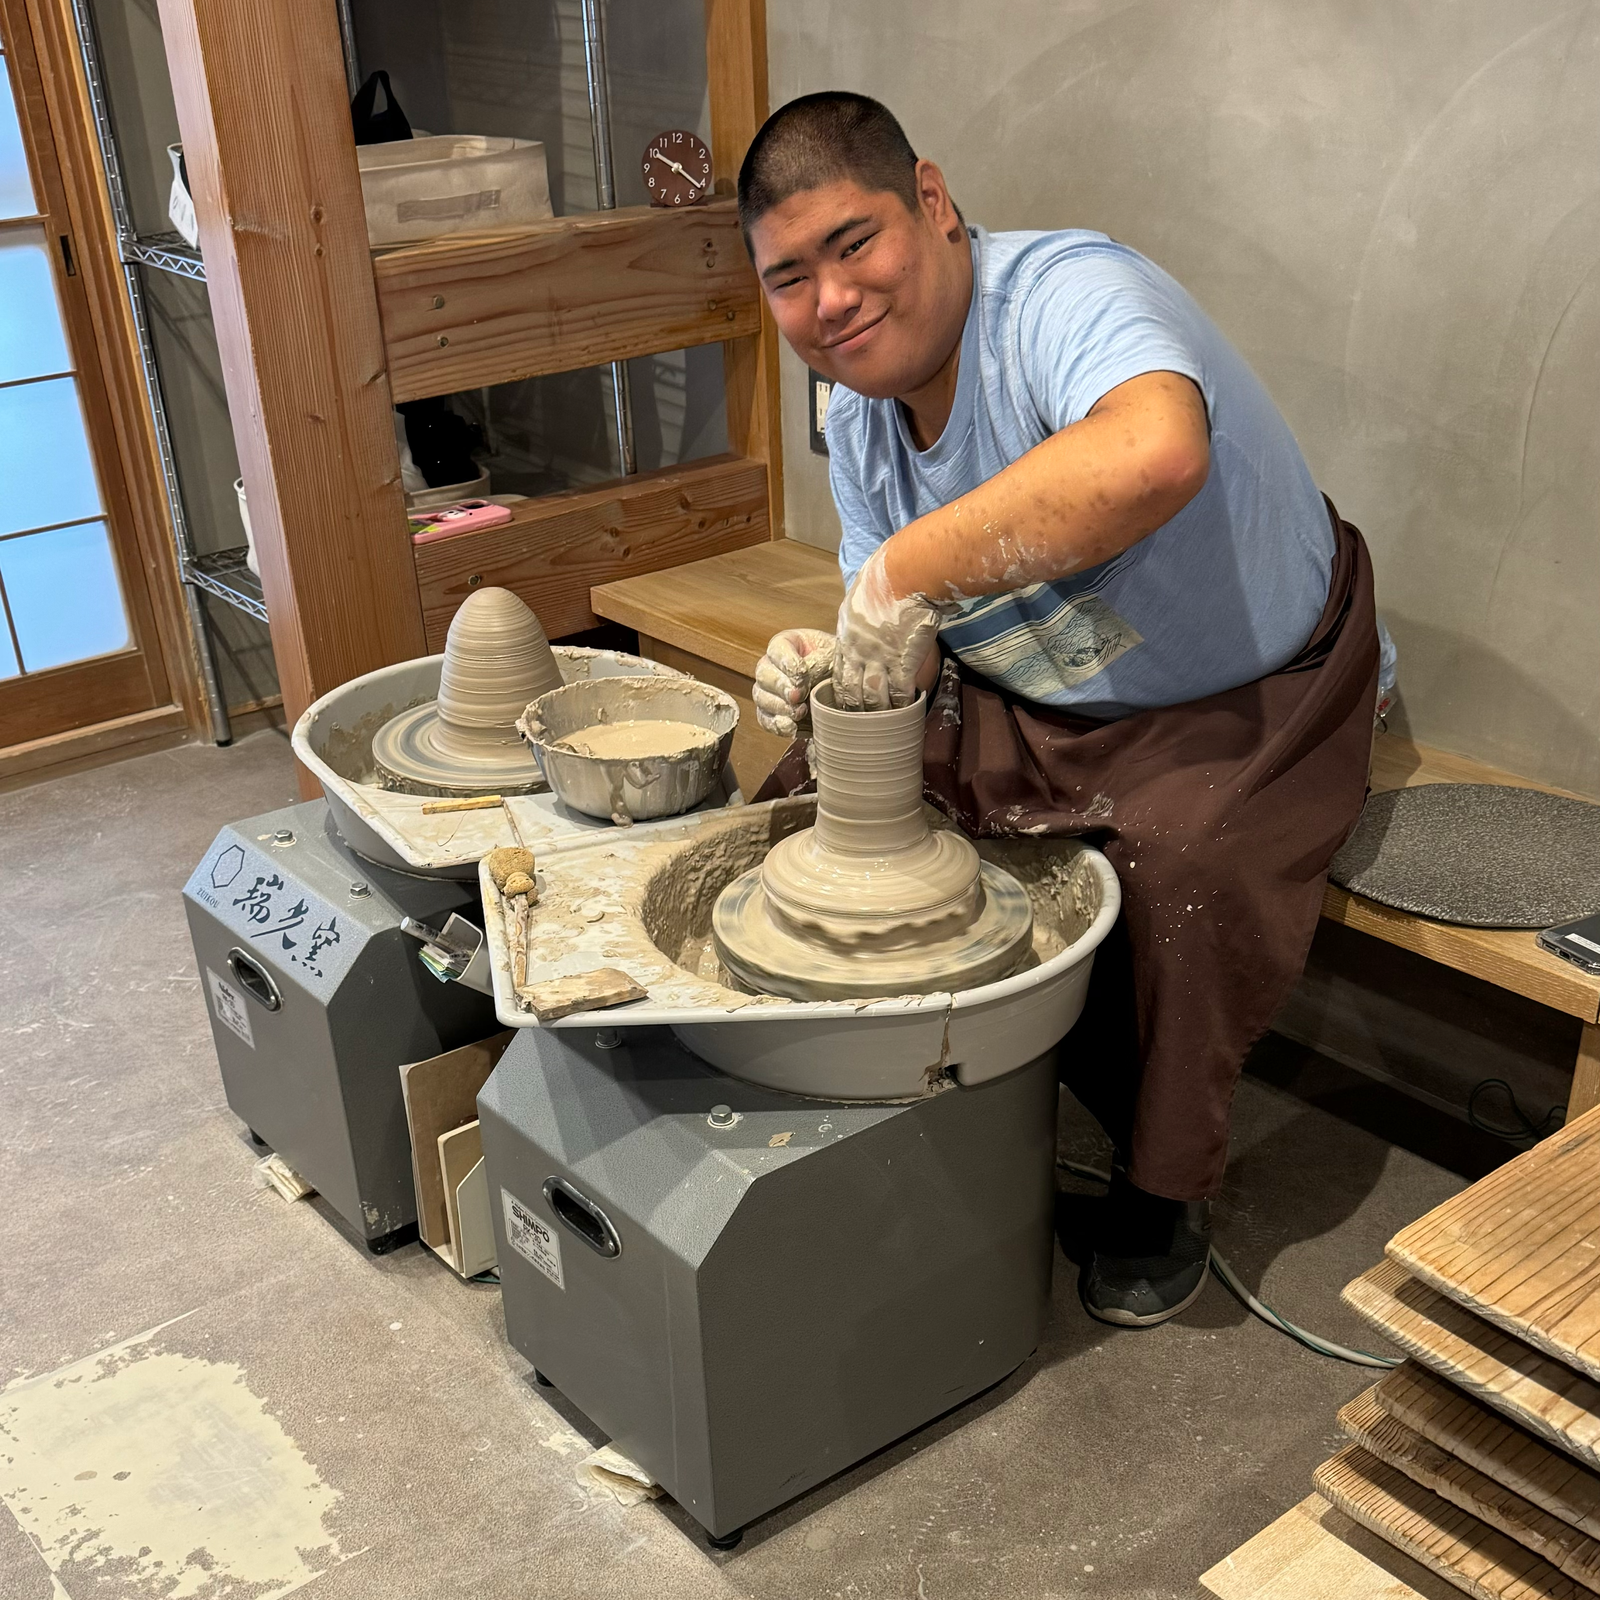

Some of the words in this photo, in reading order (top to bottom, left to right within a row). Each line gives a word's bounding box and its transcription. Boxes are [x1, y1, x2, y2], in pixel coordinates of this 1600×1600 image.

[660, 138, 667, 148] 11
[672, 133, 682, 143] 12
[690, 138, 694, 148] 1
[649, 148, 659, 158] 10
[699, 148, 706, 158] 2
[643, 163, 650, 173] 9
[702, 163, 709, 173] 3
[648, 177, 655, 187] 8
[699, 178, 706, 187] 4
[660, 188, 667, 199] 7
[688, 189, 695, 199] 5
[674, 194, 681, 204] 6
[196, 887, 220, 909] ZUIKOU
[511, 1205, 550, 1243] SHIMPO
